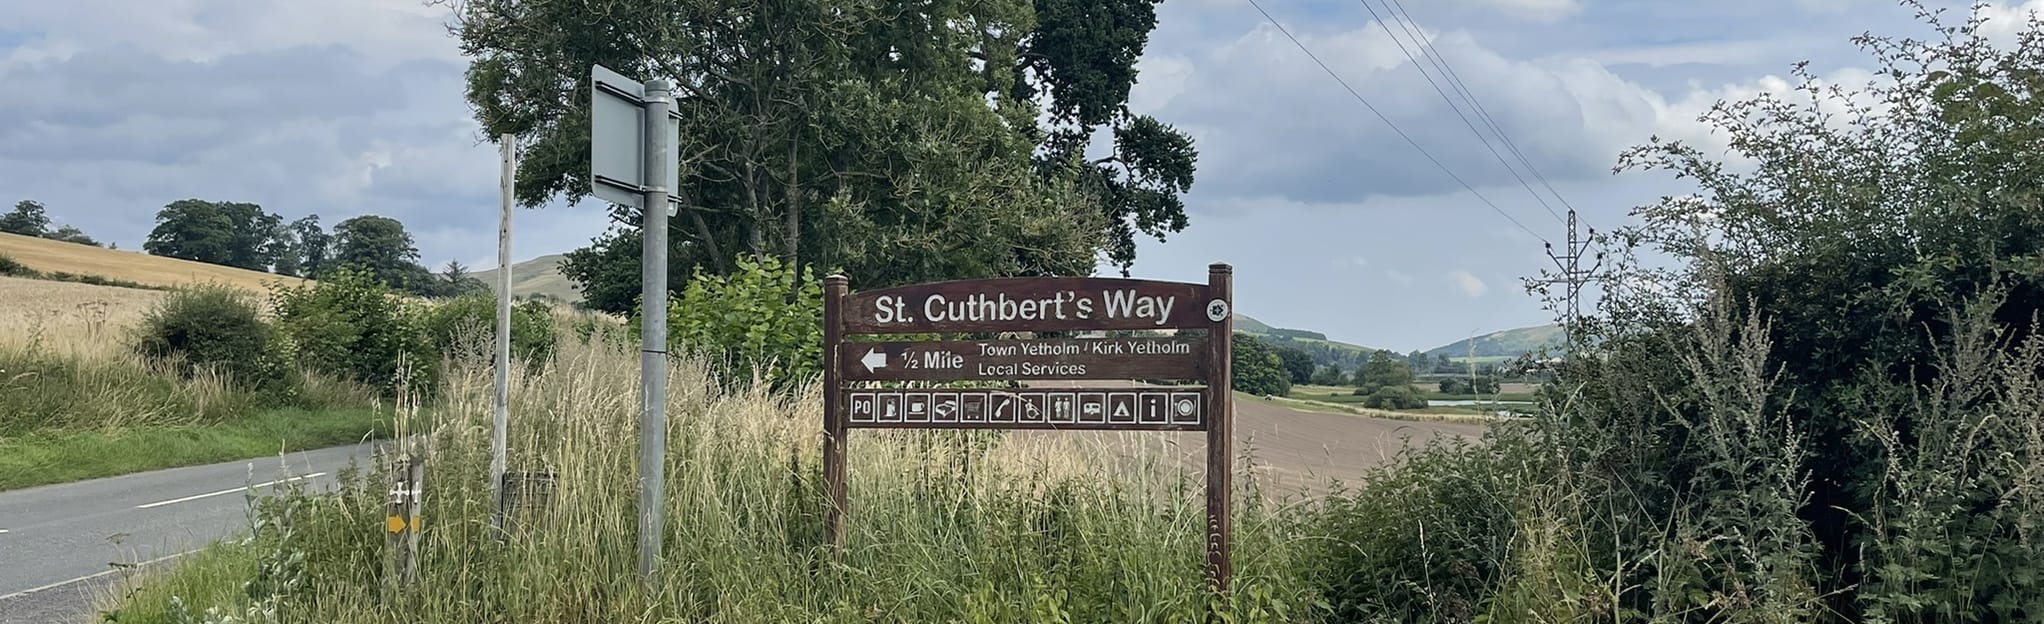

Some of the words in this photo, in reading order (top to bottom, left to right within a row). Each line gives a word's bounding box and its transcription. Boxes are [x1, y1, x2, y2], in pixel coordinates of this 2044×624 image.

[875, 295, 914, 323] St.
[1103, 289, 1175, 325] Way
[979, 343, 1017, 356] Town
[1021, 342, 1080, 356] Yetholm
[1092, 341, 1124, 355] Kirk
[1127, 340, 1190, 354] Yetholm
[924, 351, 964, 370] Mile
[978, 363, 1018, 376] Local
[1022, 362, 1087, 375] Services
[855, 400, 871, 414] PO
